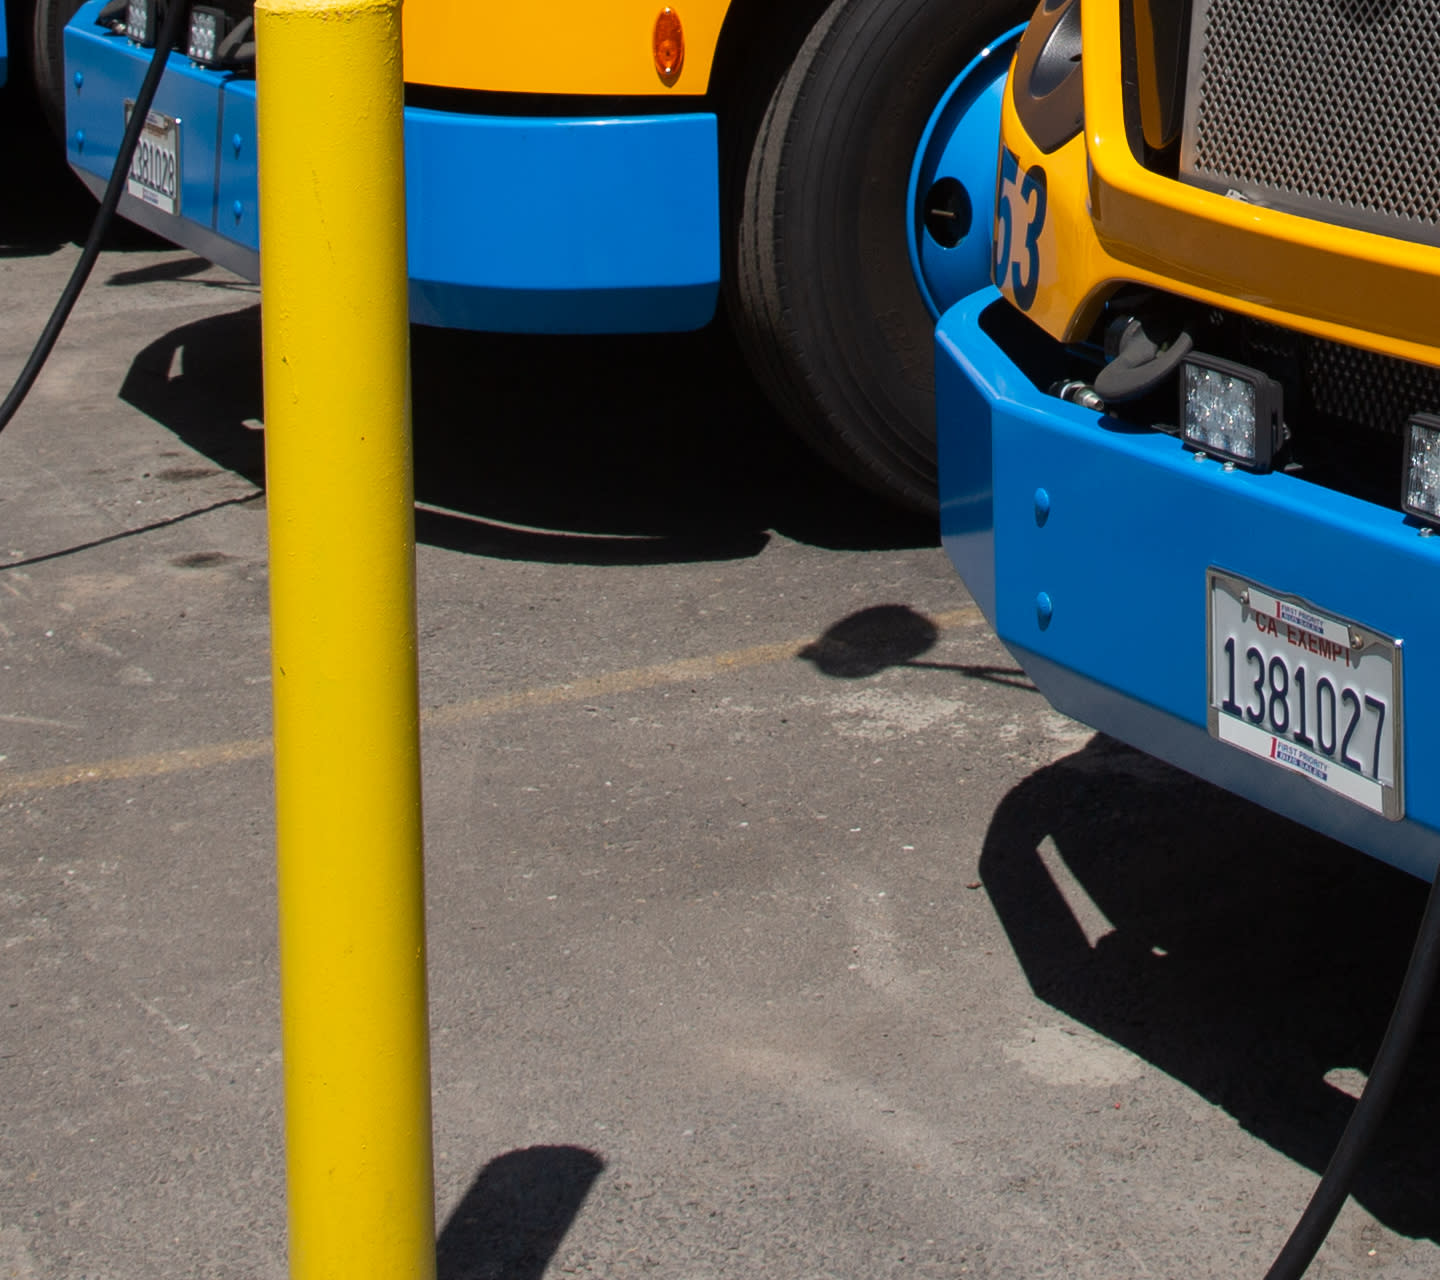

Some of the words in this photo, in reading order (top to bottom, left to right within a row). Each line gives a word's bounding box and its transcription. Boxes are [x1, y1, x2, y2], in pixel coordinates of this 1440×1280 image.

[1255, 611, 1278, 638] CA
[1287, 623, 1351, 668] EXEMPT
[1298, 609, 1324, 628] PRIORITY
[1222, 637, 1386, 780] 1381027
[1278, 741, 1297, 756] FIRST
[1299, 750, 1329, 772] PRIORITY
